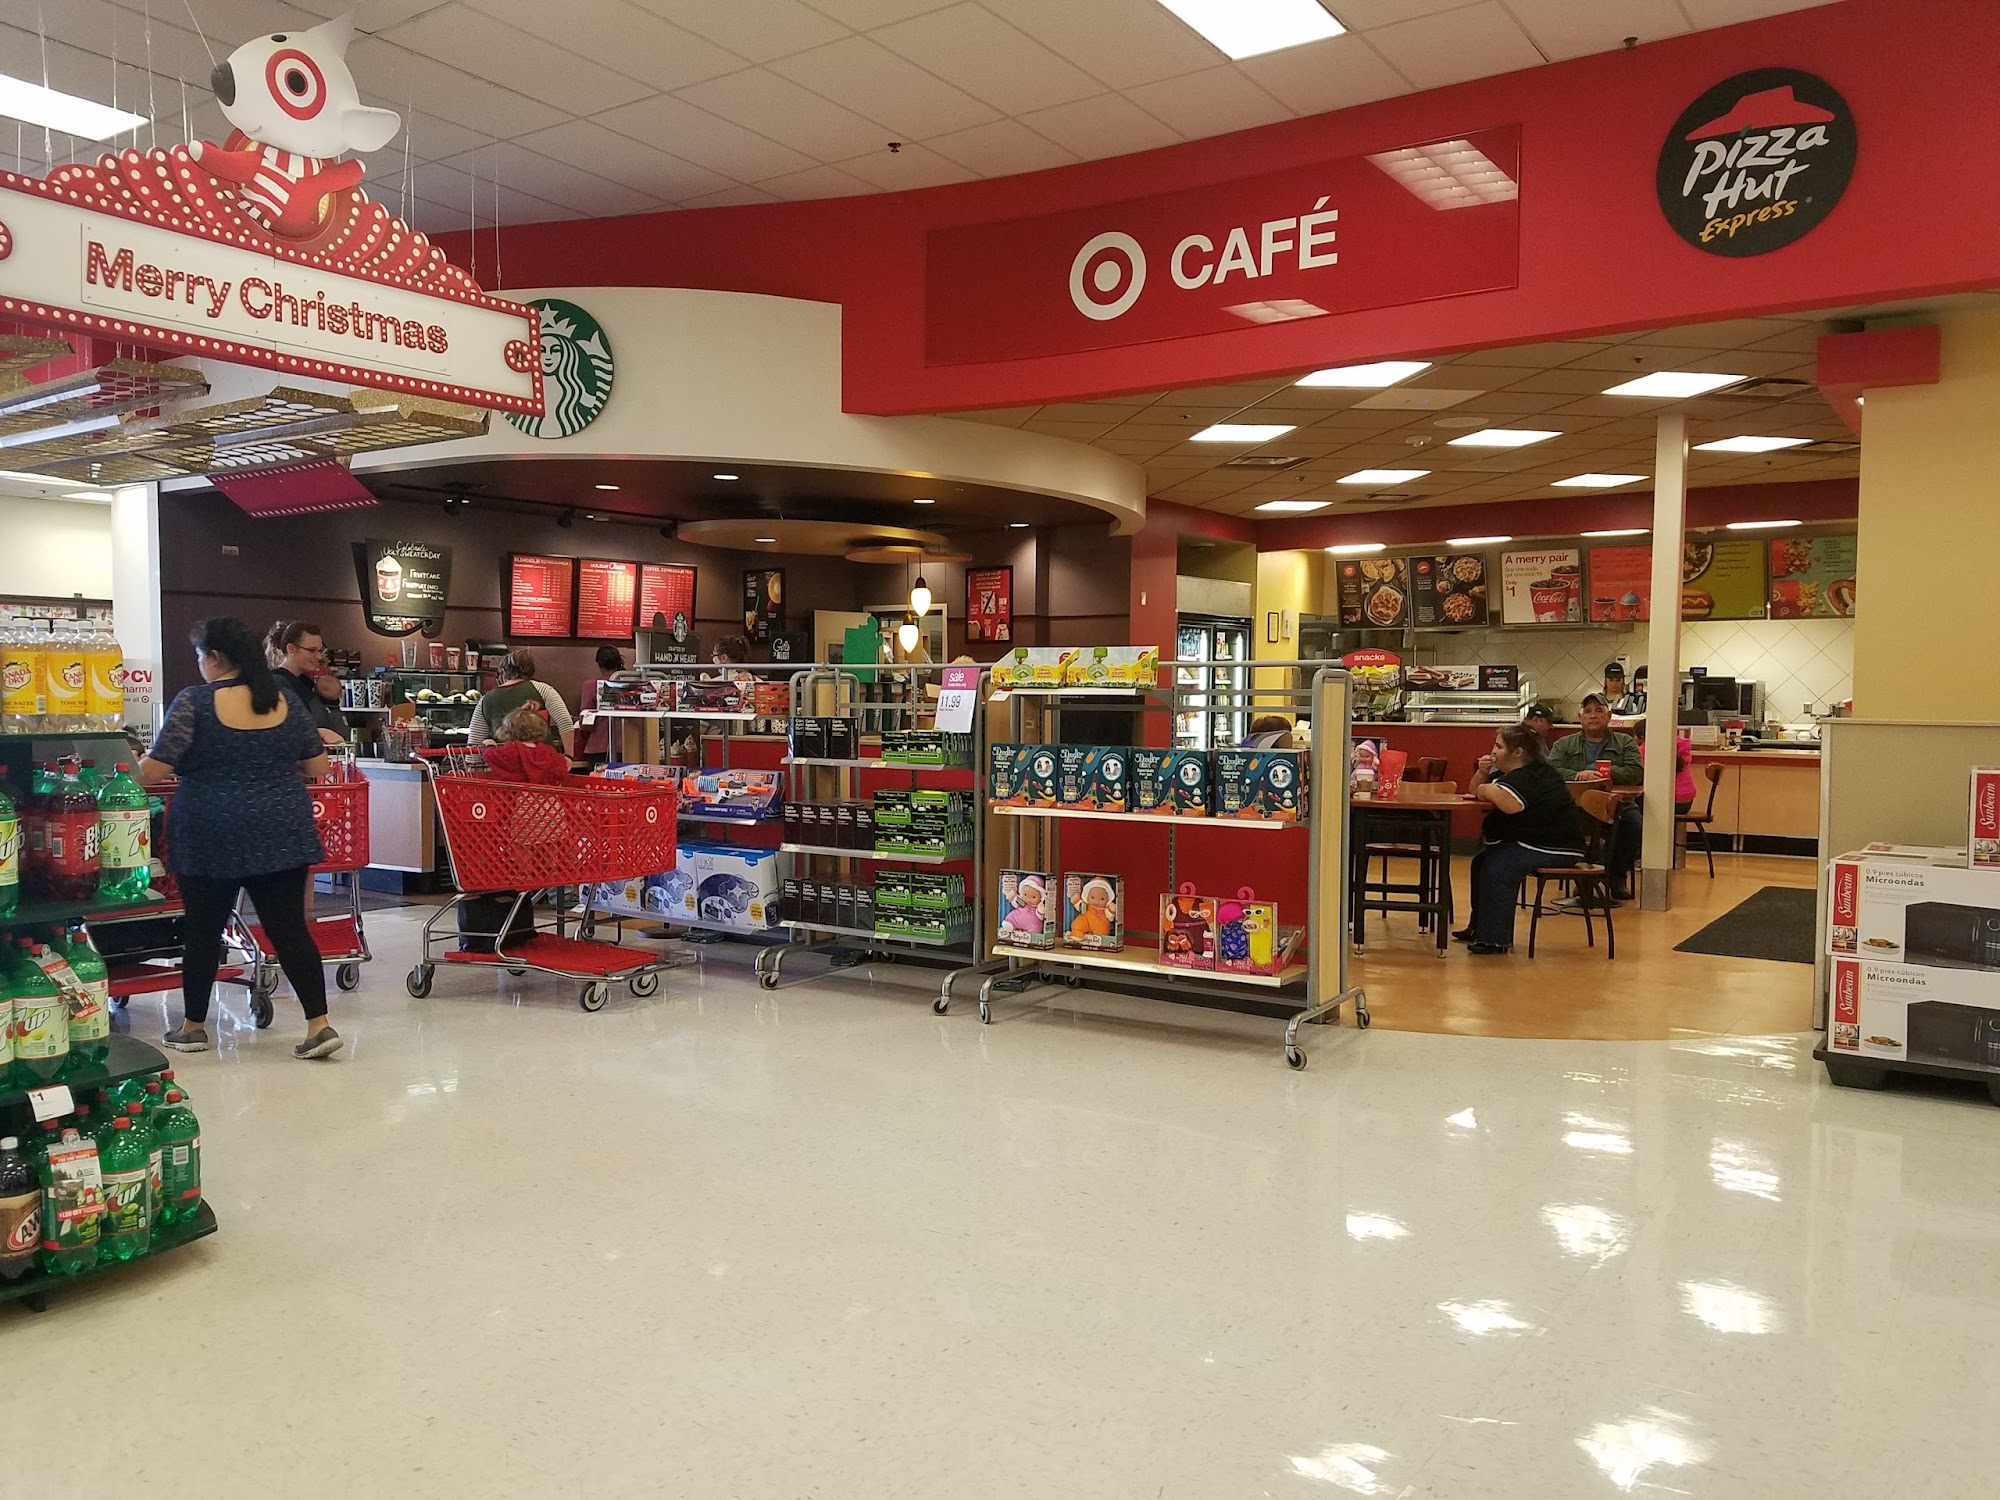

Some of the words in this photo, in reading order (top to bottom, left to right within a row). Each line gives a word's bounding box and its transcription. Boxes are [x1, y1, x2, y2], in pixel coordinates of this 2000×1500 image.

[1682, 125, 1830, 197] Pizza
[1702, 159, 1811, 220] Hut
[1698, 200, 1799, 243] Express
[1170, 195, 1339, 290] CAFÉ
[86, 240, 232, 319] Merry
[239, 277, 449, 354] Christmas
[1505, 556, 1513, 564] A
[1515, 555, 1547, 565] merry
[1549, 553, 1569, 563] pair
[1505, 586, 1516, 597] $1
[655, 652, 672, 663] HAND
[680, 654, 697, 663] HEART
[3, 667, 31, 680] ANADA
[131, 670, 152, 683] CV
[949, 669, 965, 682] sale
[123, 685, 152, 693] harma
[940, 695, 961, 708] 11.99
[1980, 782, 1996, 830] Sunbeam
[1865, 876, 1925, 887] Microondas
[1837, 873, 1853, 918] Sunbeam
[1867, 973, 1926, 985] Microondas
[1896, 969, 1925, 977] cúbicos
[1839, 970, 1854, 1015] Sunbeam
[32, 1092, 44, 1101] $1
